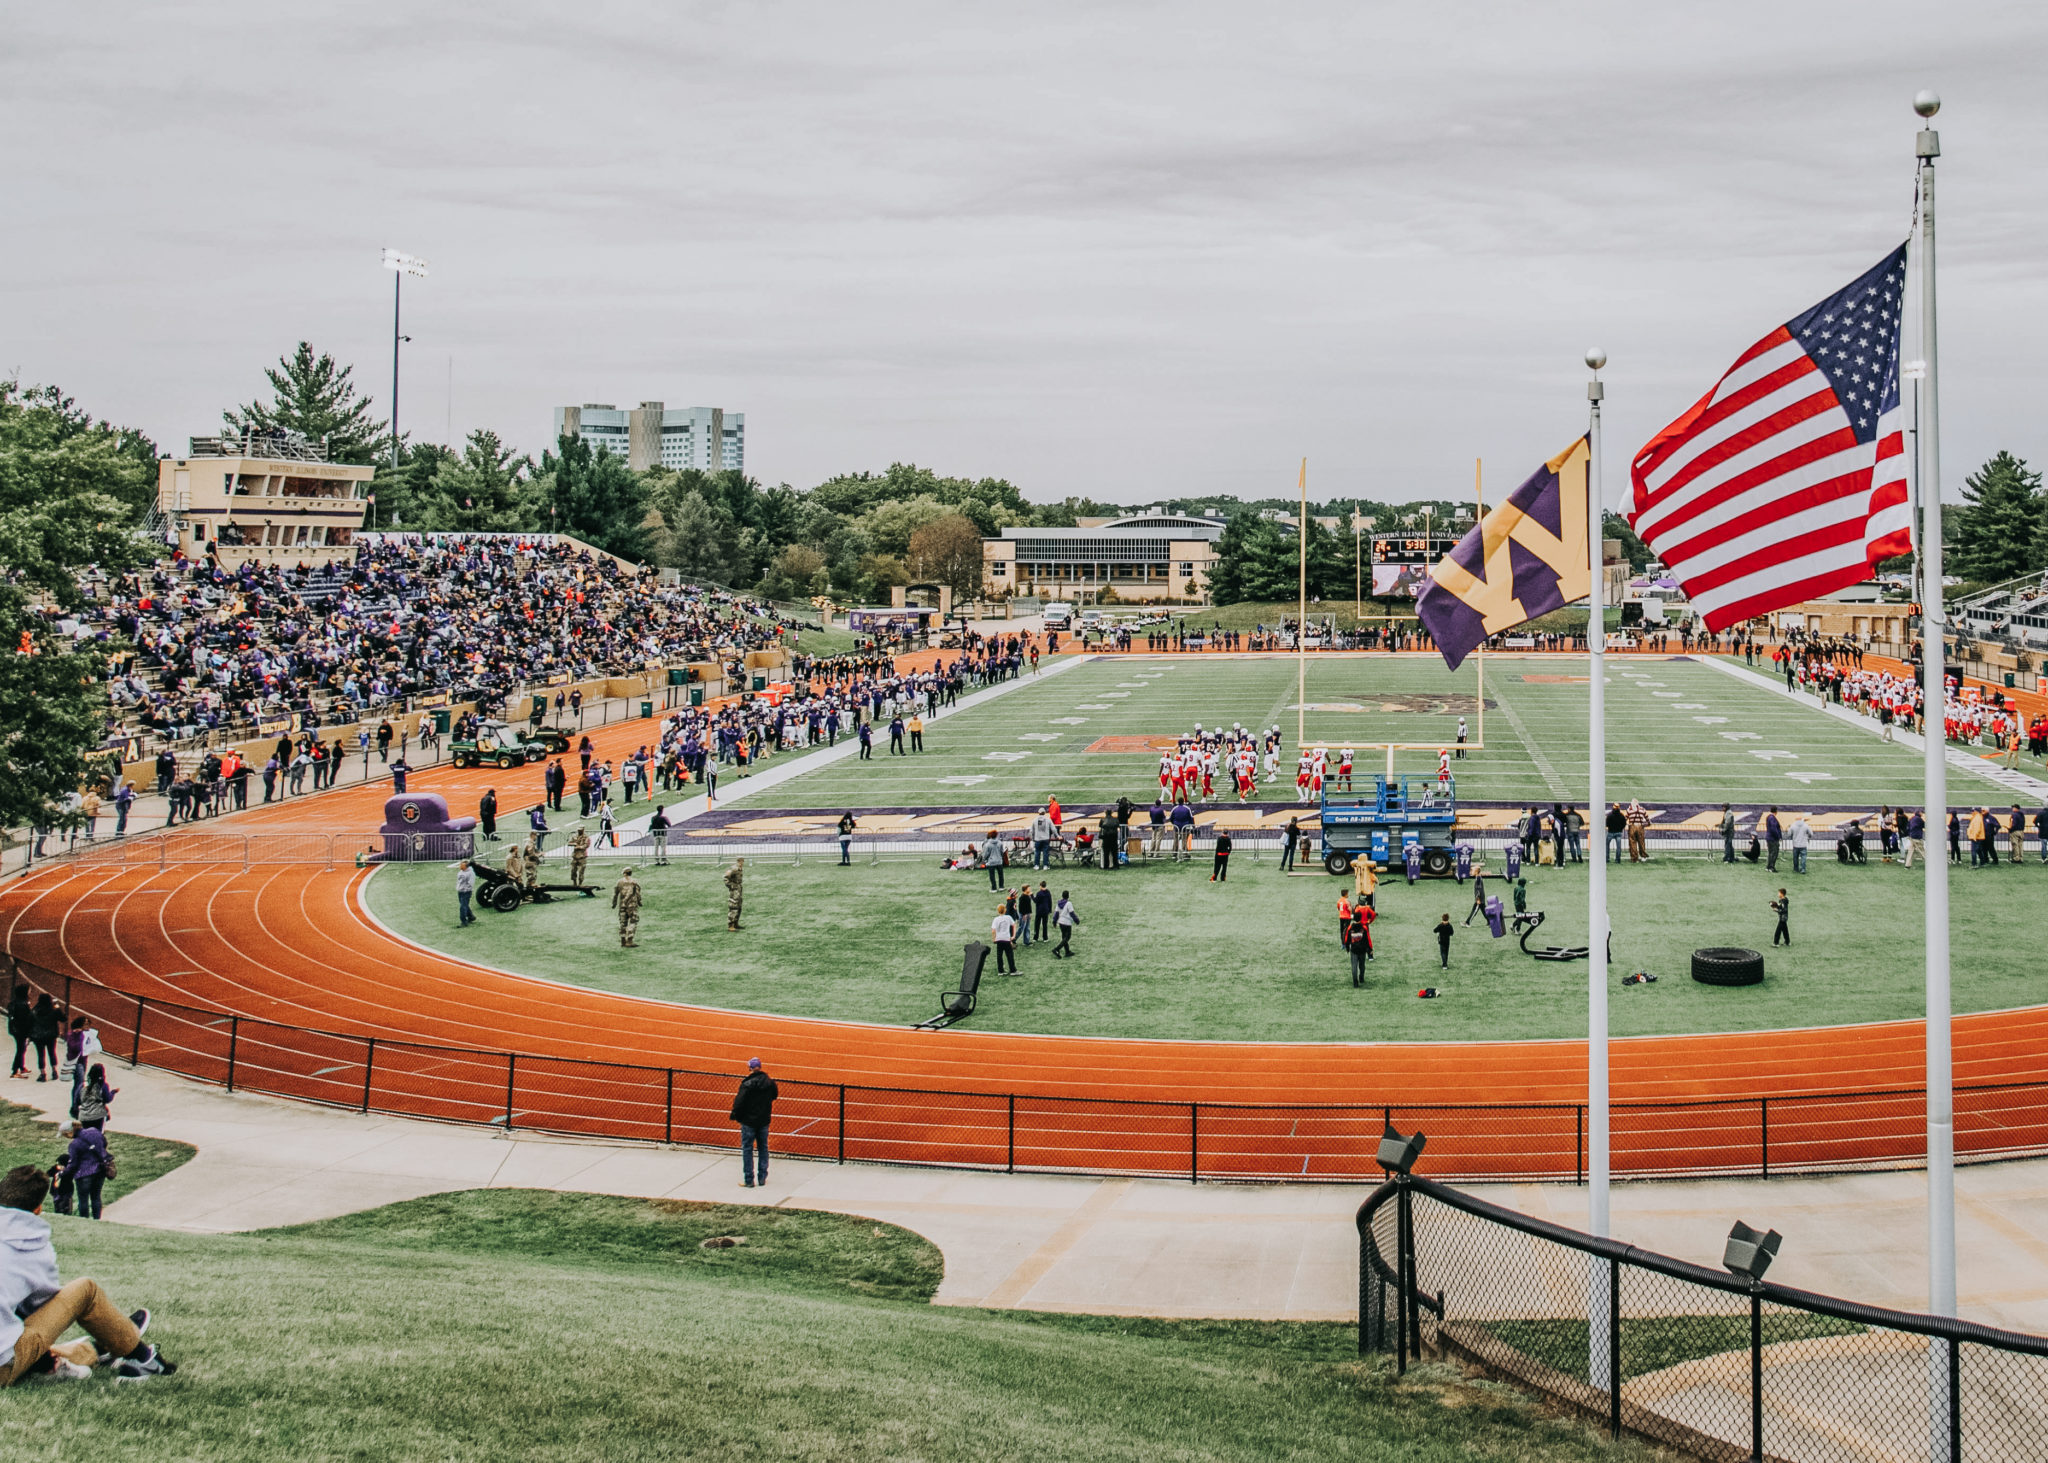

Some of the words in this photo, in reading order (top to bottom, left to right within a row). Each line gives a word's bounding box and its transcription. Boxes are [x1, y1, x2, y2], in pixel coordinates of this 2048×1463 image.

[1368, 531, 1400, 541] WESTERN
[1405, 540, 1426, 550] 5:38
[291, 712, 302, 734] B
[125, 738, 139, 762] A
[1409, 858, 1419, 866] 77
[1460, 857, 1470, 865] 77
[1510, 856, 1519, 865] 77
